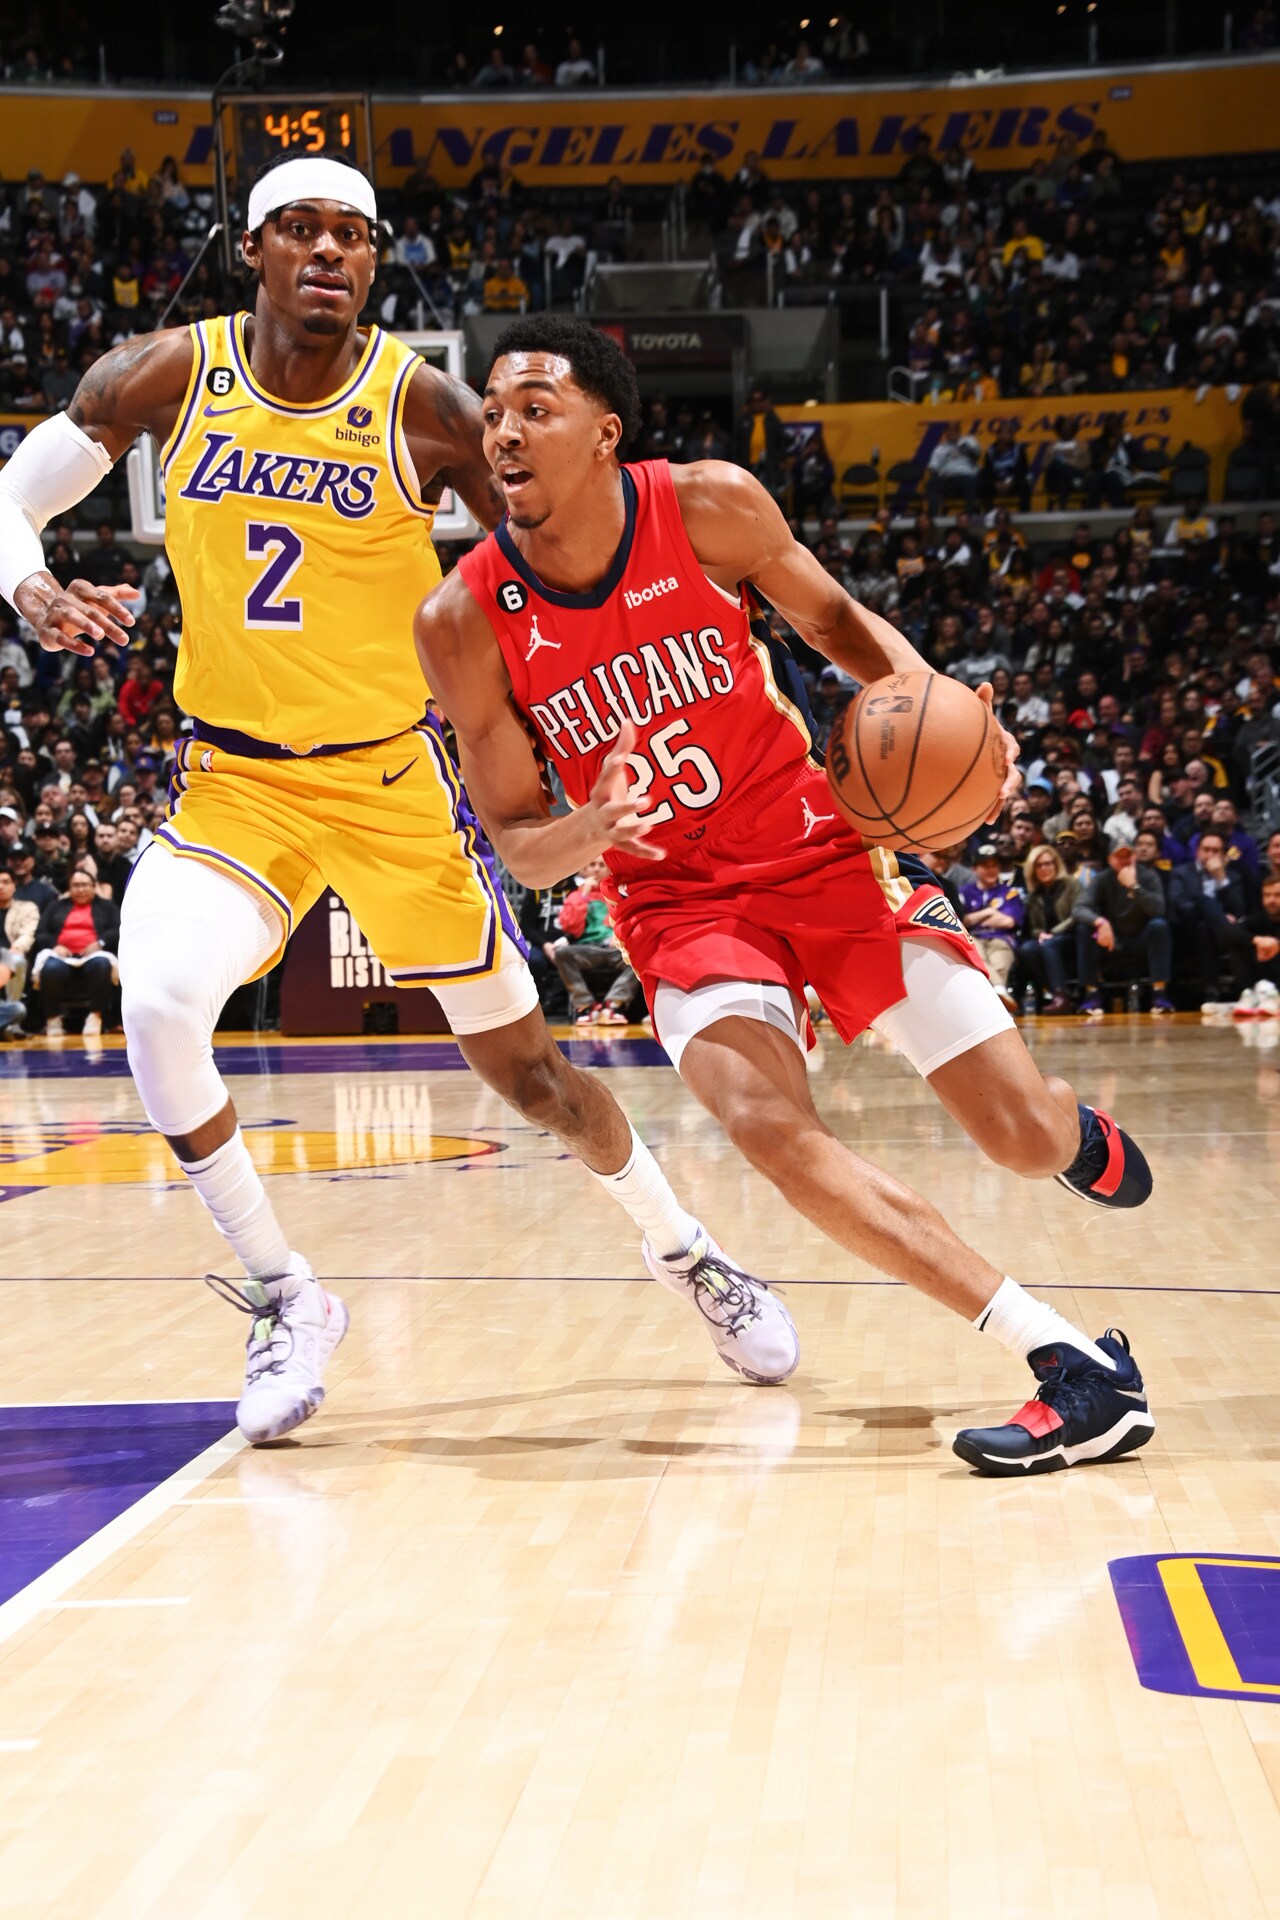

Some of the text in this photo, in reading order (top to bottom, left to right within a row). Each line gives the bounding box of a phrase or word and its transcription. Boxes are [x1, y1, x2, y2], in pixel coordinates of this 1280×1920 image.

[264, 109, 350, 151] 4:51
[374, 102, 1101, 167] ANGELES LAKERS
[630, 332, 702, 350] TOYOTA
[212, 370, 230, 394] 6
[335, 427, 380, 447] bibigo
[178, 432, 379, 520] LAKERS
[244, 520, 304, 631] 2
[502, 584, 523, 610] 6
[623, 576, 680, 610] ibotta
[530, 626, 734, 760] PELICANS
[602, 718, 723, 827] 25
[329, 910, 377, 957] BL
